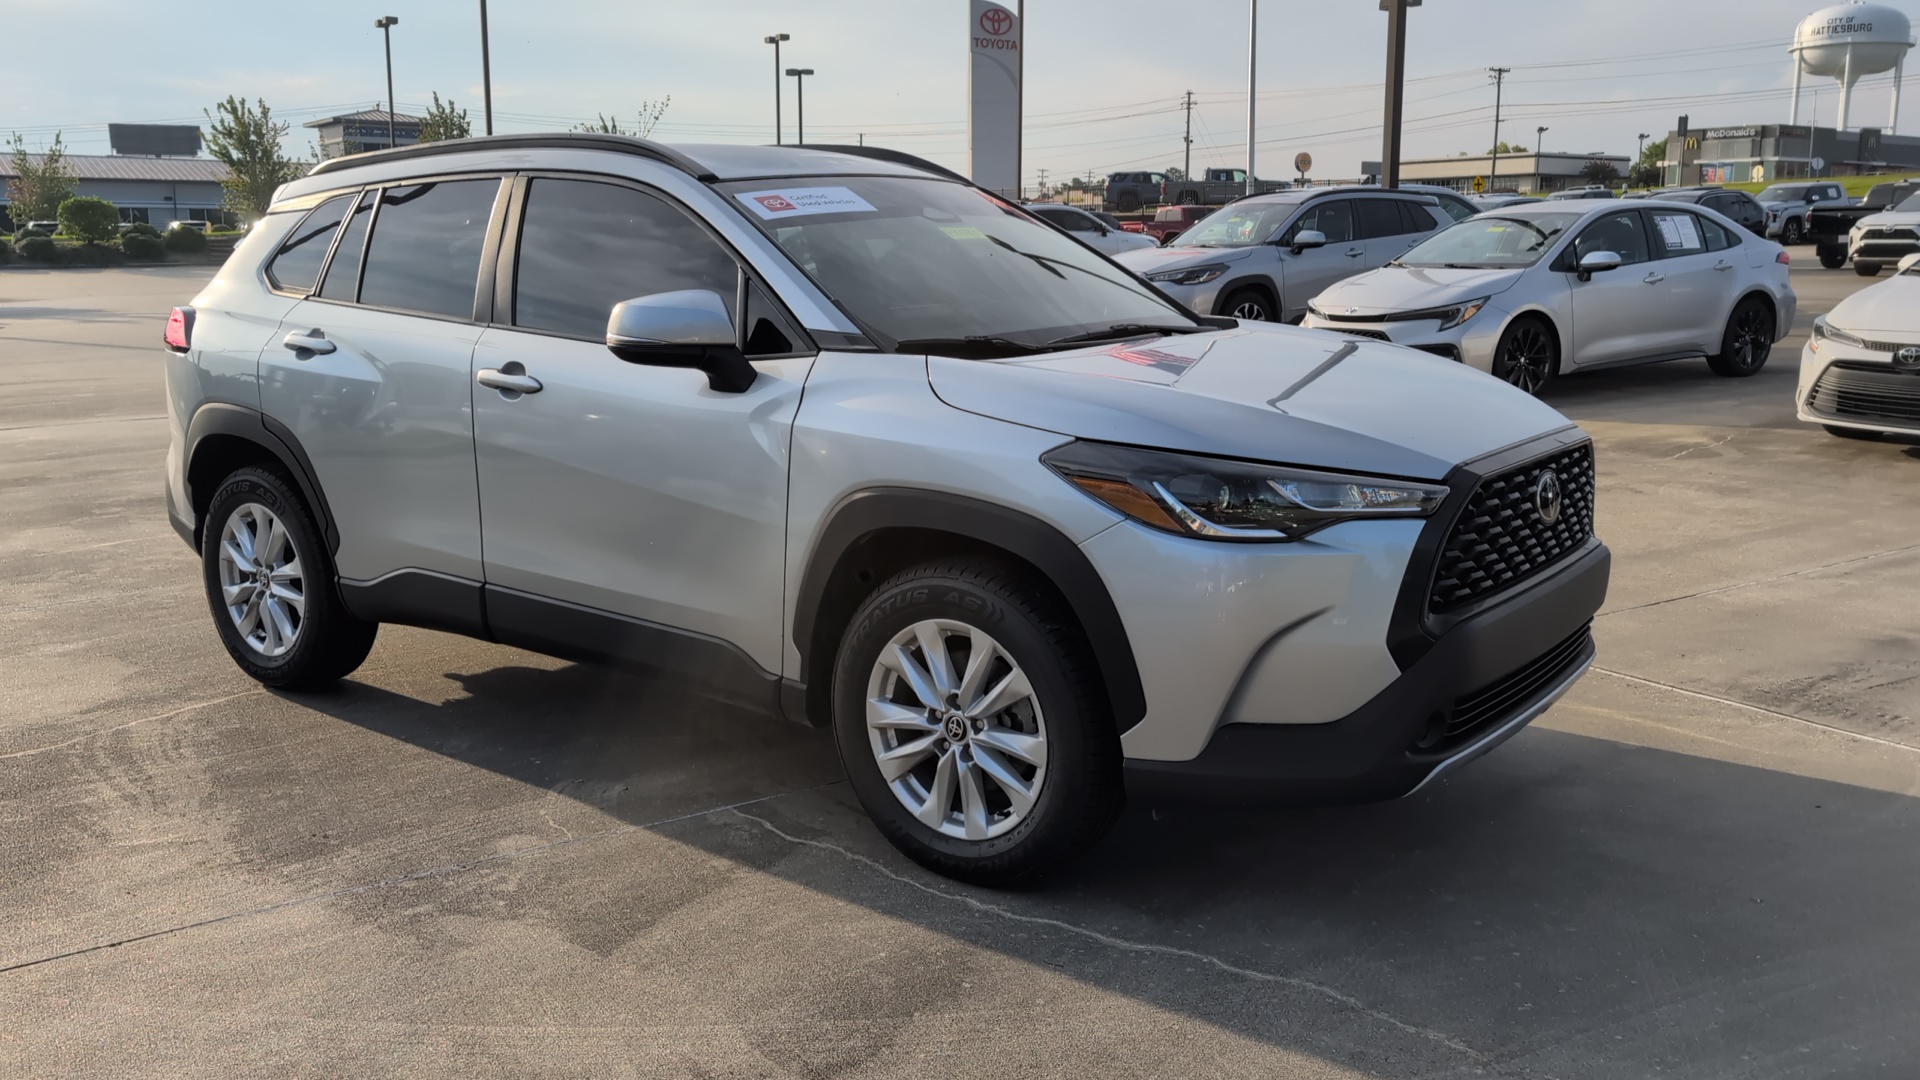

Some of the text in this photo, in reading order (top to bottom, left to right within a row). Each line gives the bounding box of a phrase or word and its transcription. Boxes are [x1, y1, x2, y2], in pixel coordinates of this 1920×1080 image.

[1827, 16, 1856, 25] CITY OF
[1811, 23, 1873, 36] HATTIESBURG
[973, 37, 1018, 50] TOYOTA
[1706, 128, 1755, 138] McDonald's
